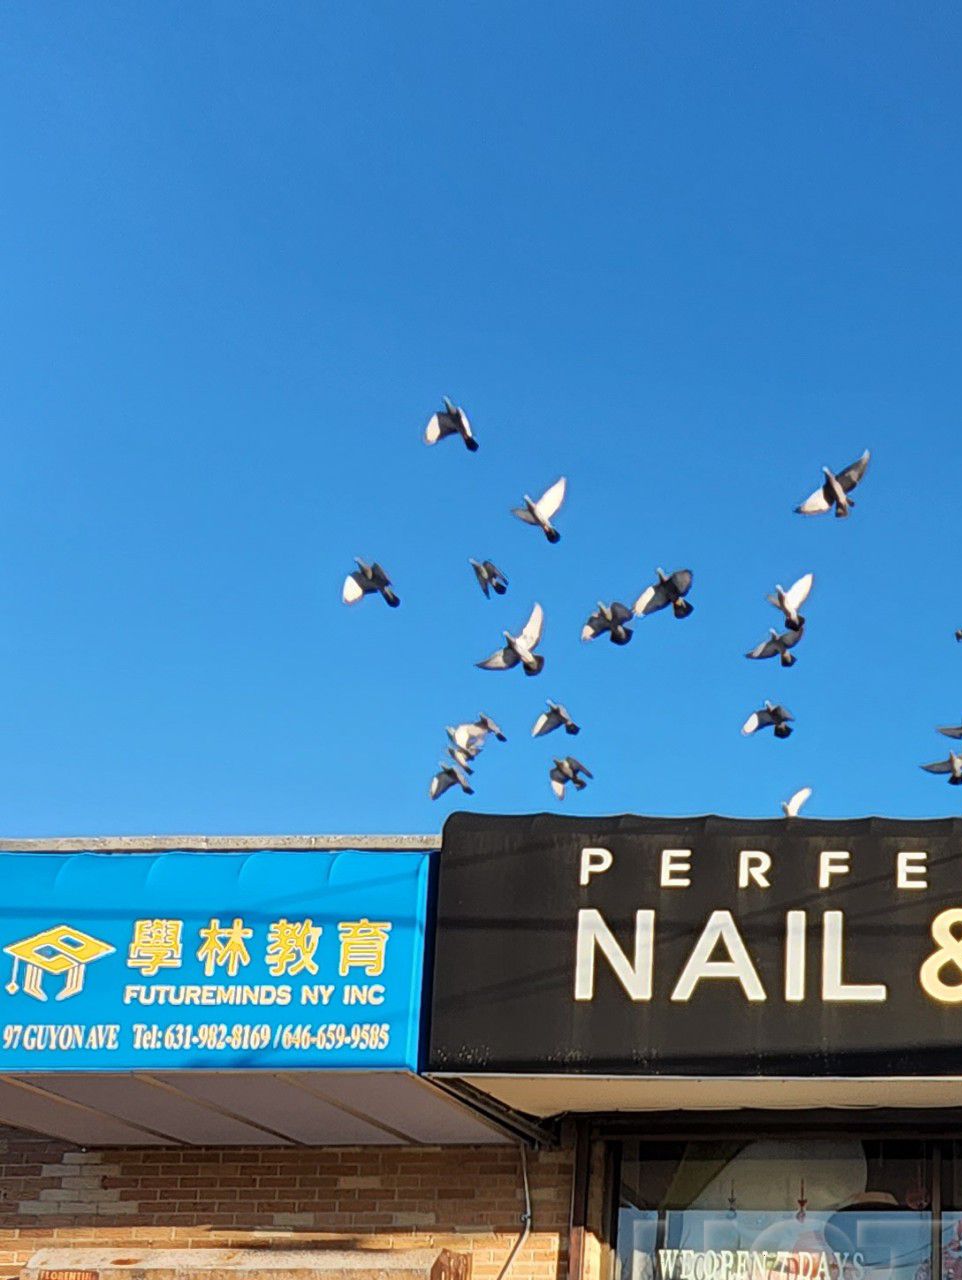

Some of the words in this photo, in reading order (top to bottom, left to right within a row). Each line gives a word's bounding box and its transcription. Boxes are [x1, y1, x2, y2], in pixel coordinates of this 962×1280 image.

[127, 918, 392, 976] 學林教育
[575, 908, 887, 1002] NAIL
[124, 984, 292, 1005] FUTUREMINDS
[301, 984, 334, 1005] NY
[343, 984, 385, 1005] INC
[3, 1025, 22, 1049] 97
[24, 1025, 86, 1050] GUYON
[86, 1025, 120, 1050] AVE
